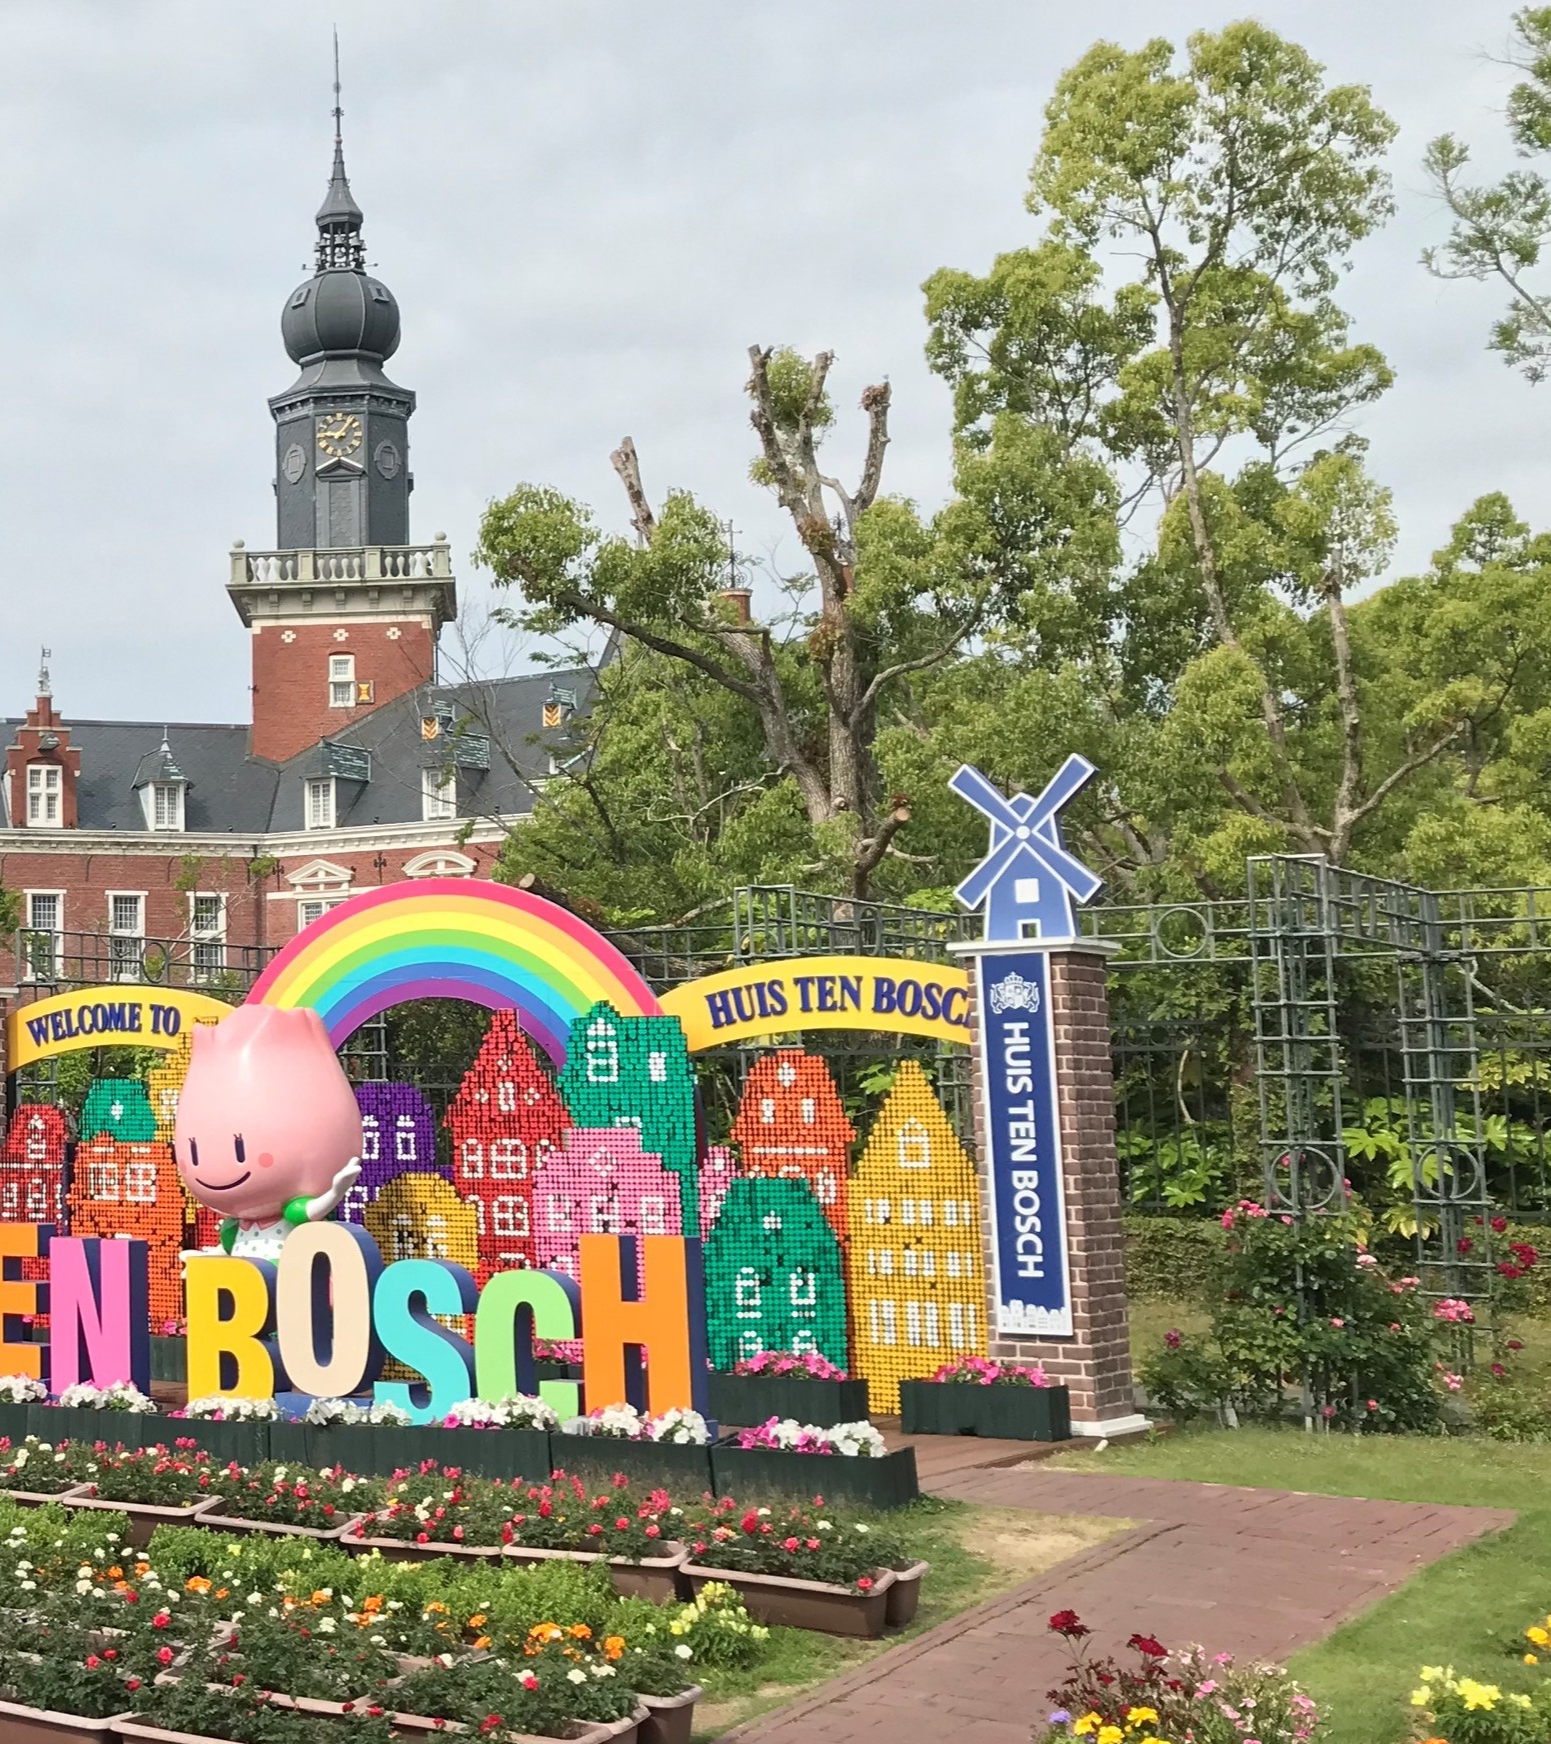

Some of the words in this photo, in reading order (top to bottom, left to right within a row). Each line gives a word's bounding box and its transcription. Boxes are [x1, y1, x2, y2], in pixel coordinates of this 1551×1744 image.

[26, 1002, 142, 1047] WELCOME
[150, 1003, 181, 1036] TO
[704, 978, 788, 1029] HUIS
[793, 975, 863, 1013] TEN
[1002, 1021, 1032, 1094] HUIS
[1007, 1099, 1036, 1164] TEN
[1010, 1169, 1044, 1279] BOSCH
[187, 1221, 693, 1421] BOSCH
